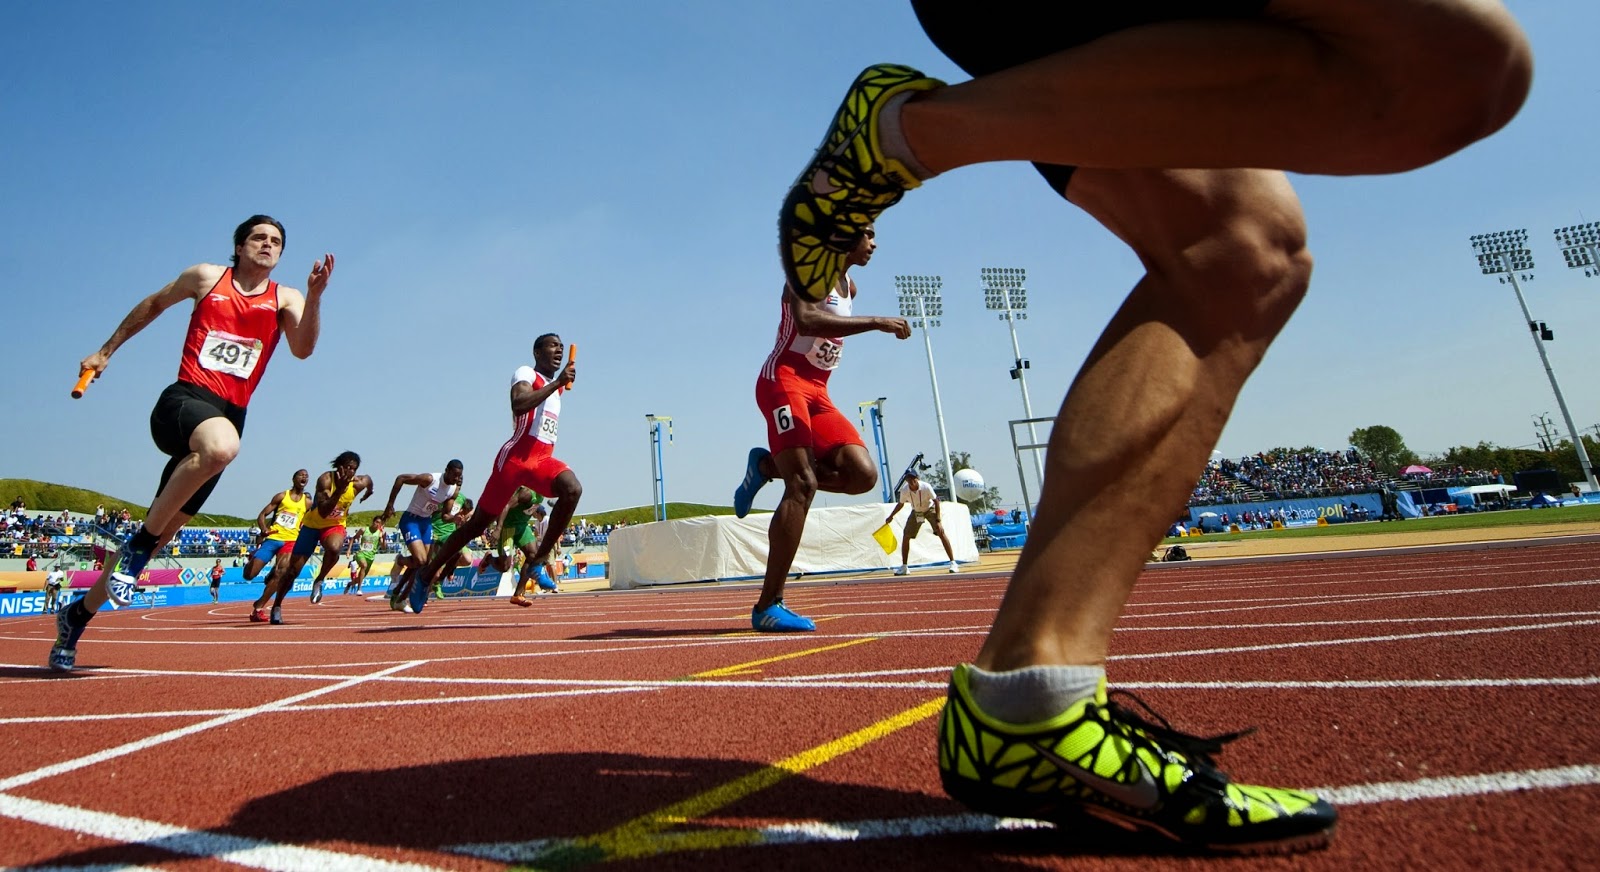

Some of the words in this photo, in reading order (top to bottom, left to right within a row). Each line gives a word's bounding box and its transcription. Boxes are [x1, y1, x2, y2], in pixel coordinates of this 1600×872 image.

[209, 342, 253, 368] 491
[778, 407, 790, 431] 6
[1317, 503, 1344, 518] 2011
[280, 514, 295, 525] 574
[292, 580, 313, 592] Estad
[338, 577, 370, 588] TEEX
